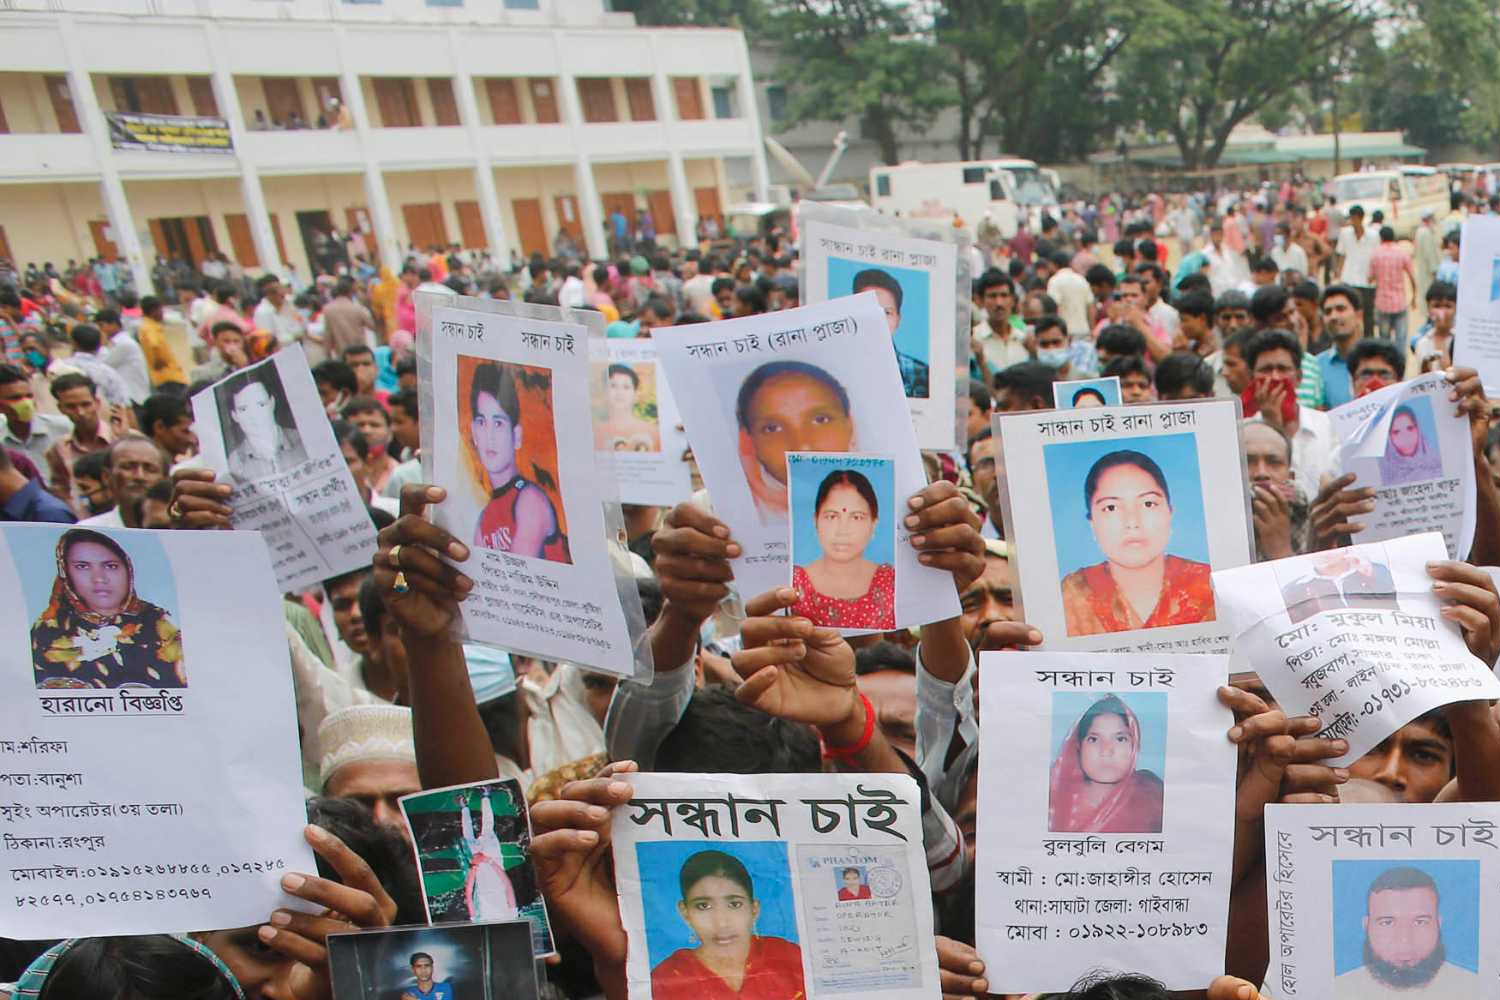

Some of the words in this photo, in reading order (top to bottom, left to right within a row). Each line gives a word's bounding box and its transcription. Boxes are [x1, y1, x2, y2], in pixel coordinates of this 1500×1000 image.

[554, 334, 576, 353] চাই
[685, 341, 728, 360] সন্ধান
[733, 334, 761, 353] চাই
[767, 328, 808, 350] (রানা
[1088, 413, 1117, 433] চাই
[1122, 414, 1153, 431] রানা
[1392, 610, 1437, 632] মিয়া
[1034, 668, 1115, 689] সন্ধান
[1126, 667, 1177, 689] চাই
[1346, 665, 1377, 690] লাইন
[39, 695, 114, 714] হারানো
[119, 690, 184, 713] বিজ্ঞপ্তি
[0, 773, 83, 791] পতা:বানুশা
[144, 803, 184, 818] তলা)
[627, 792, 788, 838] সন্ধান
[801, 784, 911, 842] চাই
[3, 833, 106, 852] ঠিকানা:রংপুর
[1042, 835, 1107, 857] বুলবুলি
[1115, 839, 1165, 854] বেগম
[1309, 823, 1415, 849] সন্ধান
[1277, 831, 1293, 884] হিসেবে
[996, 866, 1034, 887] স্বামী
[1158, 871, 1213, 887] হোসেন
[1094, 897, 1132, 915] জেলা:
[1138, 896, 1190, 915] গাইবান্ধা
[1006, 925, 1048, 941] মোবা
[1069, 921, 1209, 940] ০১৯২২-১০৮৯৮৩
[1279, 888, 1295, 959] অপারেটর
